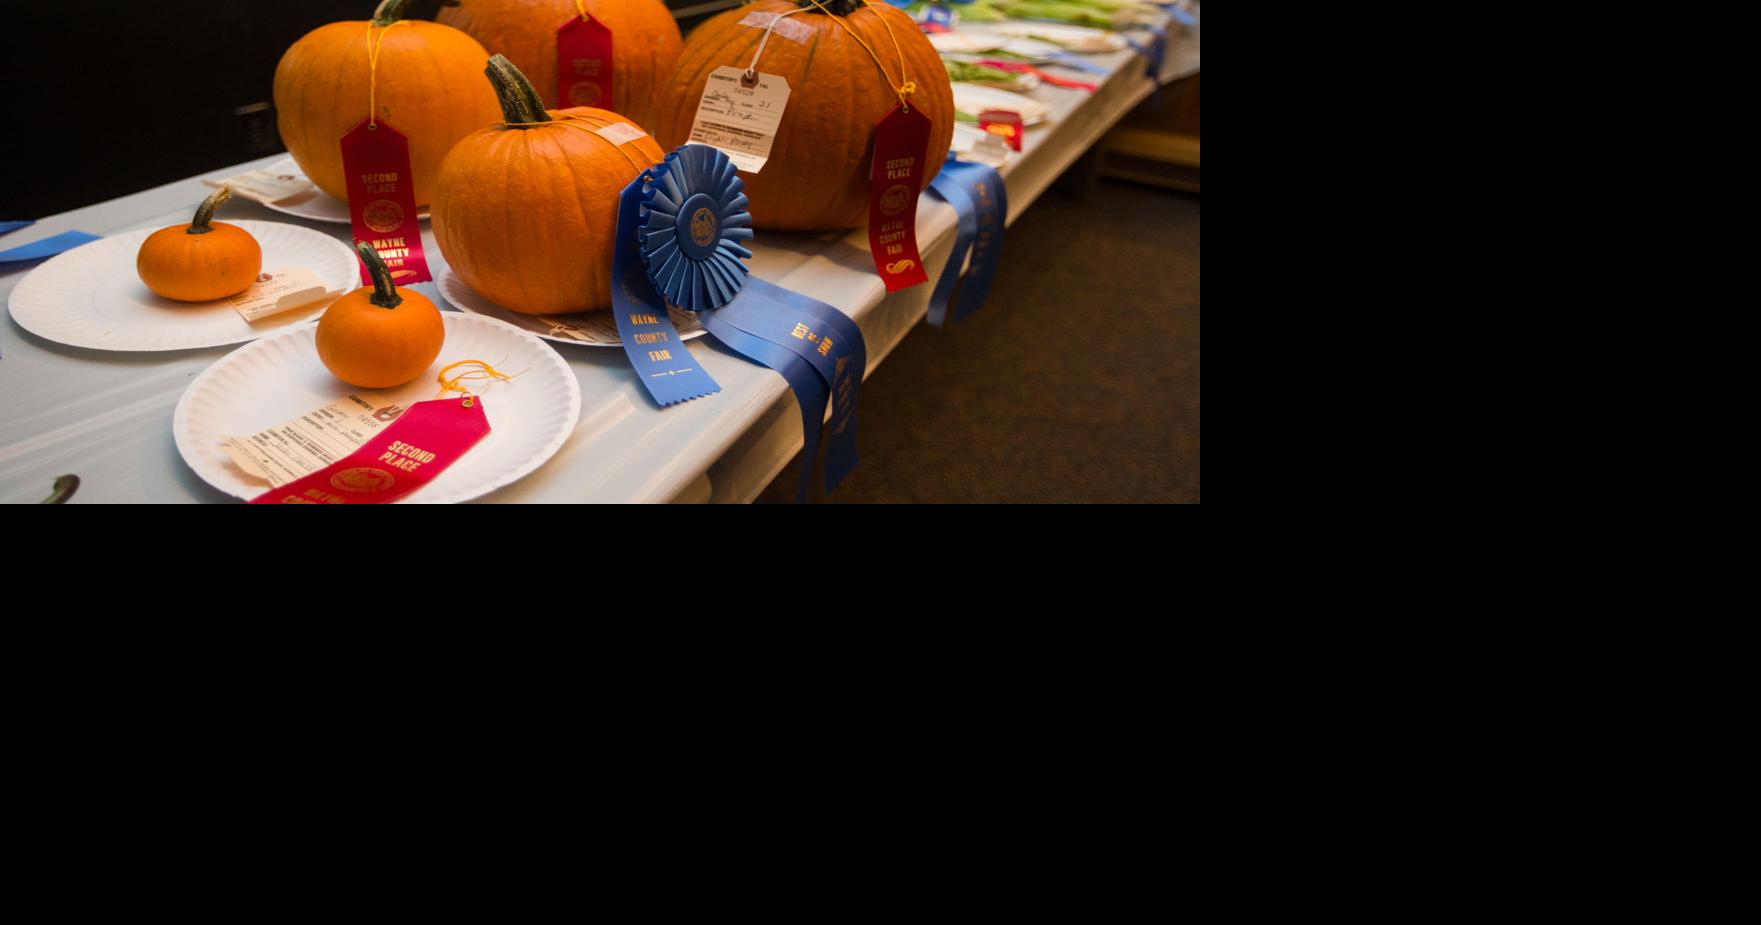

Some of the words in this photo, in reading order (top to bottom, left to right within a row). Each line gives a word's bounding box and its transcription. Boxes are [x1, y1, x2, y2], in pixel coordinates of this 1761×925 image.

[886, 157, 914, 169] SECOND
[361, 172, 398, 184] SECOND
[887, 168, 911, 179] PLACE
[366, 183, 396, 193] PLACE
[372, 237, 406, 249] WAYNE
[377, 248, 409, 259] OUNTY
[629, 313, 659, 326] WAYNE
[633, 332, 668, 345] COUNTY
[648, 349, 673, 362] FAIR
[388, 440, 436, 463] SECOND
[378, 451, 421, 472] PLACE
